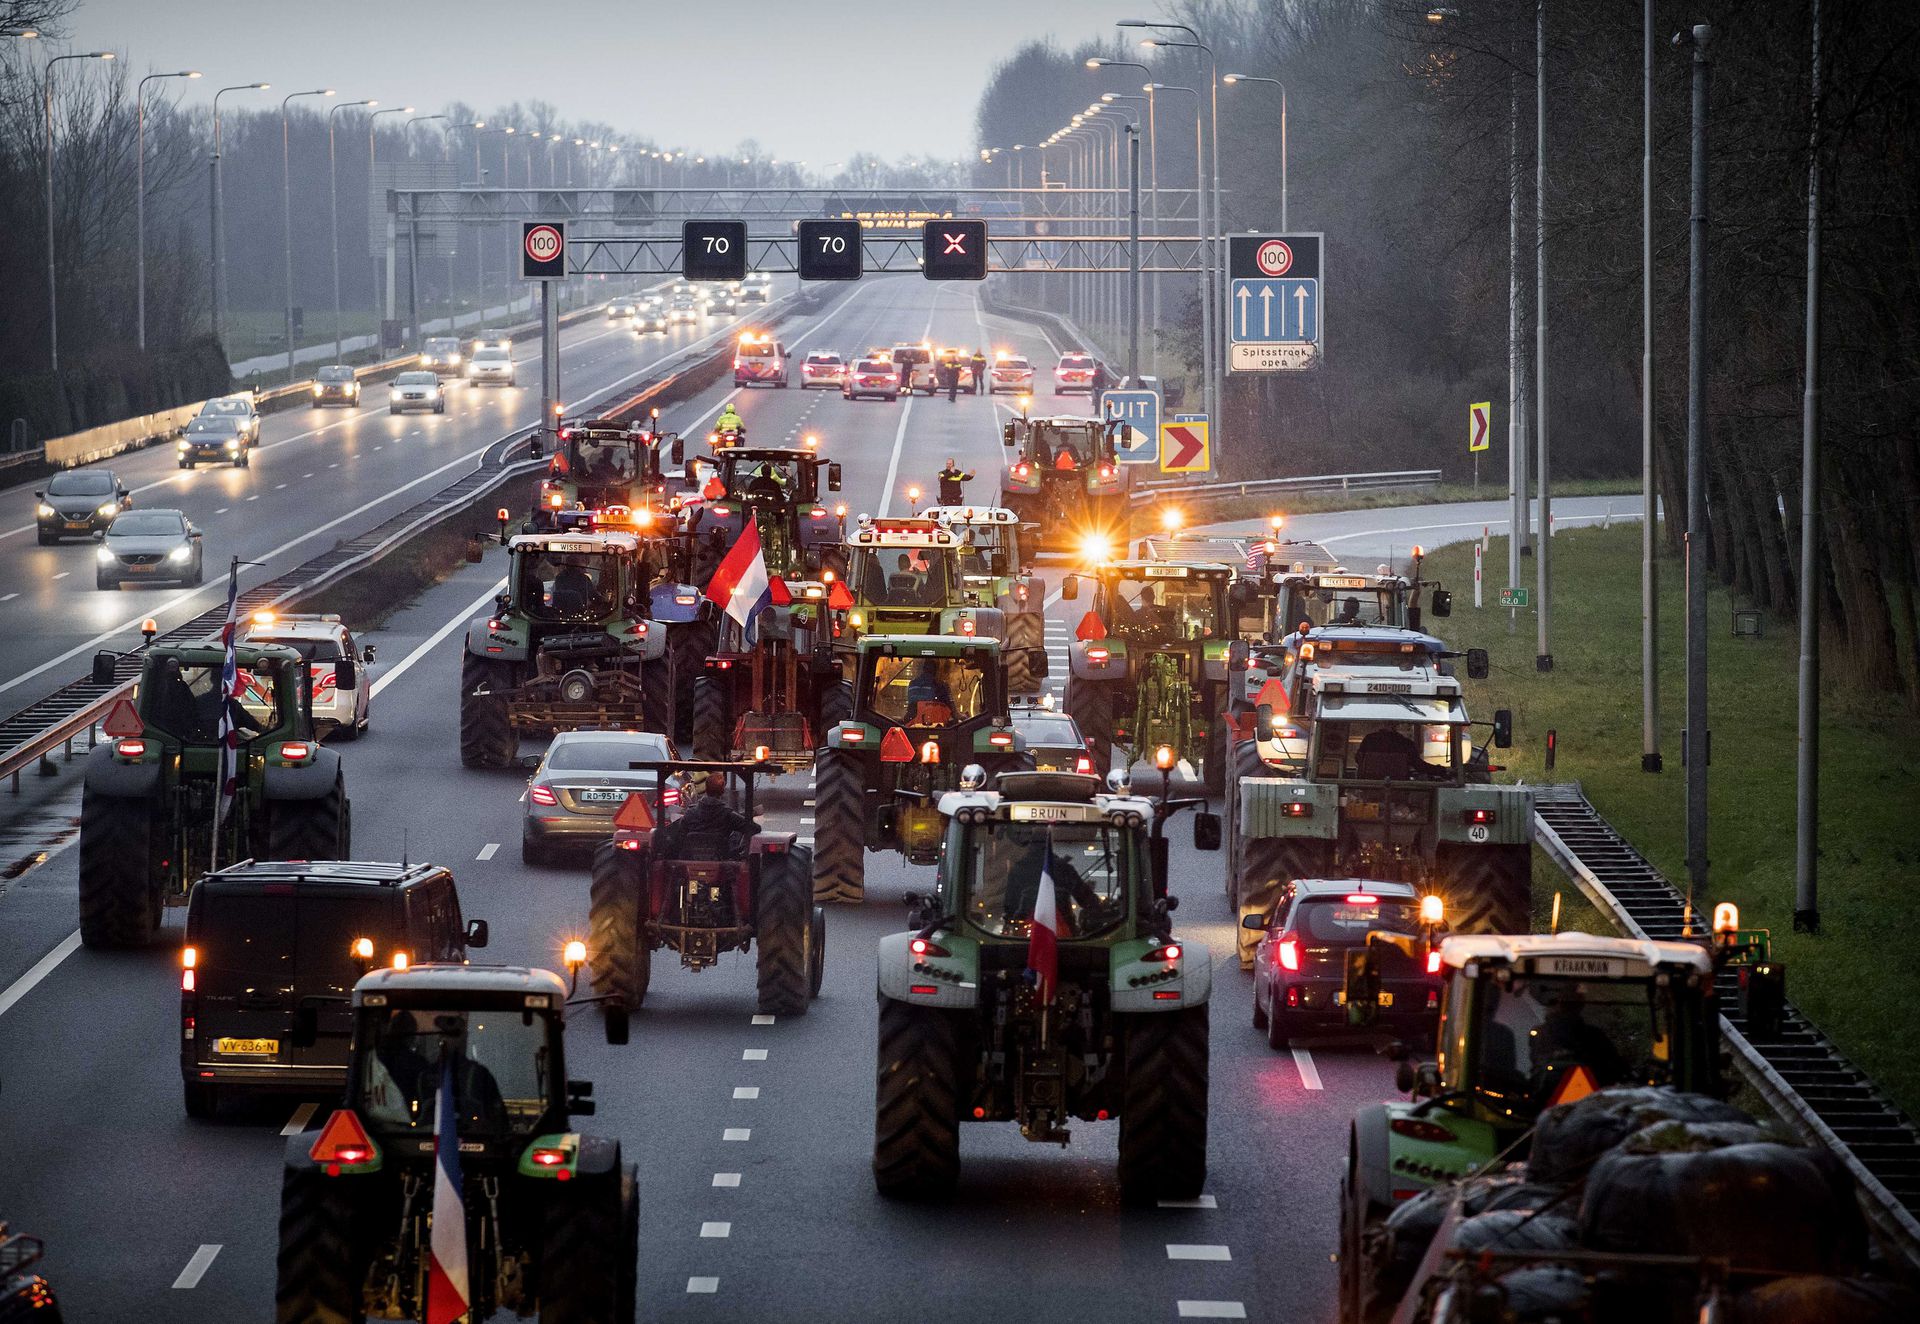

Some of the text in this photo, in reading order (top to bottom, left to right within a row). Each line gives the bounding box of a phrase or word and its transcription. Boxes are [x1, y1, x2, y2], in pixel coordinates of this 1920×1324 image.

[532, 237, 555, 250] 100
[702, 237, 730, 254] 70
[818, 237, 846, 254] 70
[1263, 251, 1286, 265] 100
[1242, 347, 1307, 358] Spitsstrook
[1261, 359, 1288, 369] open
[1110, 401, 1148, 418] UIT
[560, 543, 582, 551] WISSE
[1501, 597, 1519, 605] 62.0
[586, 791, 624, 801] RD-951-K
[1031, 807, 1067, 819] BRUIN
[1471, 826, 1485, 840] 40
[221, 1040, 275, 1052] VV-636-N
